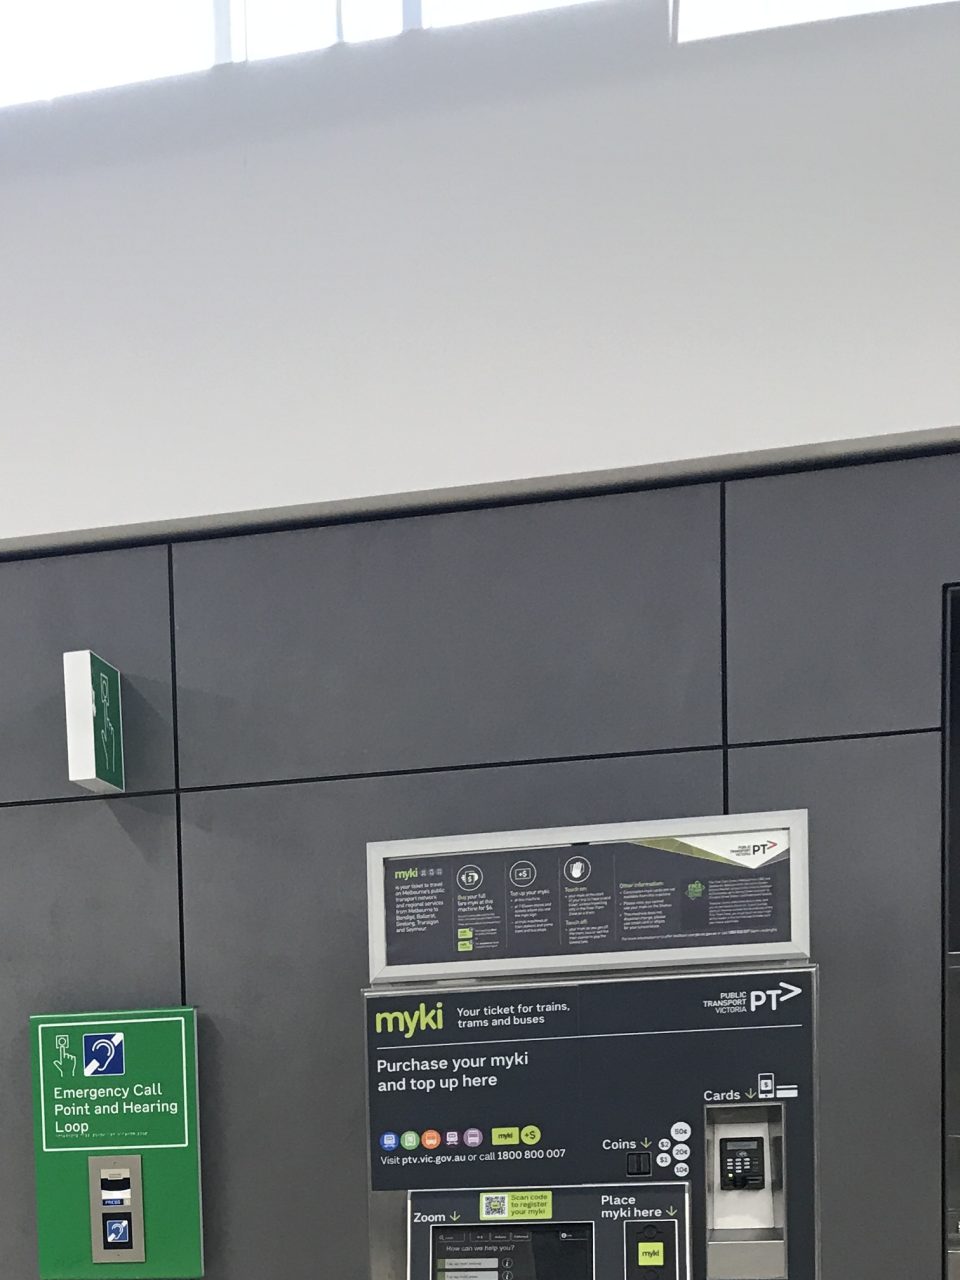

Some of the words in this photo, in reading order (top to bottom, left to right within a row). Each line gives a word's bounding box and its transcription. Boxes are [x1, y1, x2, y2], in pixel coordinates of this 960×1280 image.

[394, 867, 418, 881] myki
[720, 991, 747, 999] PUBLIC
[750, 989, 782, 1012] PT
[456, 1006, 481, 1017] Your
[483, 1004, 515, 1016] ticket
[517, 1002, 532, 1014] for
[536, 1001, 570, 1013] trains,
[703, 998, 747, 1008] TRANSPORT
[715, 1006, 748, 1014] VICTORIA
[375, 1001, 444, 1039] myki
[457, 1018, 490, 1028] trams
[491, 1016, 511, 1027] and
[513, 1014, 545, 1026] buses
[376, 1057, 448, 1073] Purchase
[452, 1055, 487, 1072] your
[490, 1052, 529, 1070] myki
[378, 1077, 406, 1092] and
[410, 1078, 436, 1092] top
[440, 1078, 459, 1091] up
[462, 1074, 498, 1088] here
[54, 1086, 130, 1101] Emergency
[132, 1082, 163, 1096] Call
[704, 1090, 741, 1101] Cards
[54, 1102, 91, 1116] Point
[94, 1102, 119, 1114] and
[122, 1100, 178, 1115] Hearing
[55, 1120, 90, 1134] Loop
[498, 1132, 513, 1140] myki
[602, 1138, 637, 1150] Coins
[660, 1140, 670, 1148] $2
[380, 1156, 400, 1165] Visit
[402, 1154, 466, 1166] ptv.vic.gov.au
[468, 1154, 477, 1162] or
[478, 1152, 496, 1161] call
[497, 1150, 522, 1160] 1800
[524, 1150, 544, 1160] 800
[546, 1148, 566, 1158] 007
[520, 1201, 548, 1209] register
[601, 1194, 636, 1206] Place
[413, 1212, 446, 1222] Zoom
[528, 1208, 546, 1216] myki
[601, 1207, 631, 1220] myki
[633, 1207, 662, 1218] here
[446, 1244, 460, 1252] How
[484, 1244, 498, 1252] help
[500, 1244, 515, 1252] you?
[642, 1250, 660, 1258] myki
